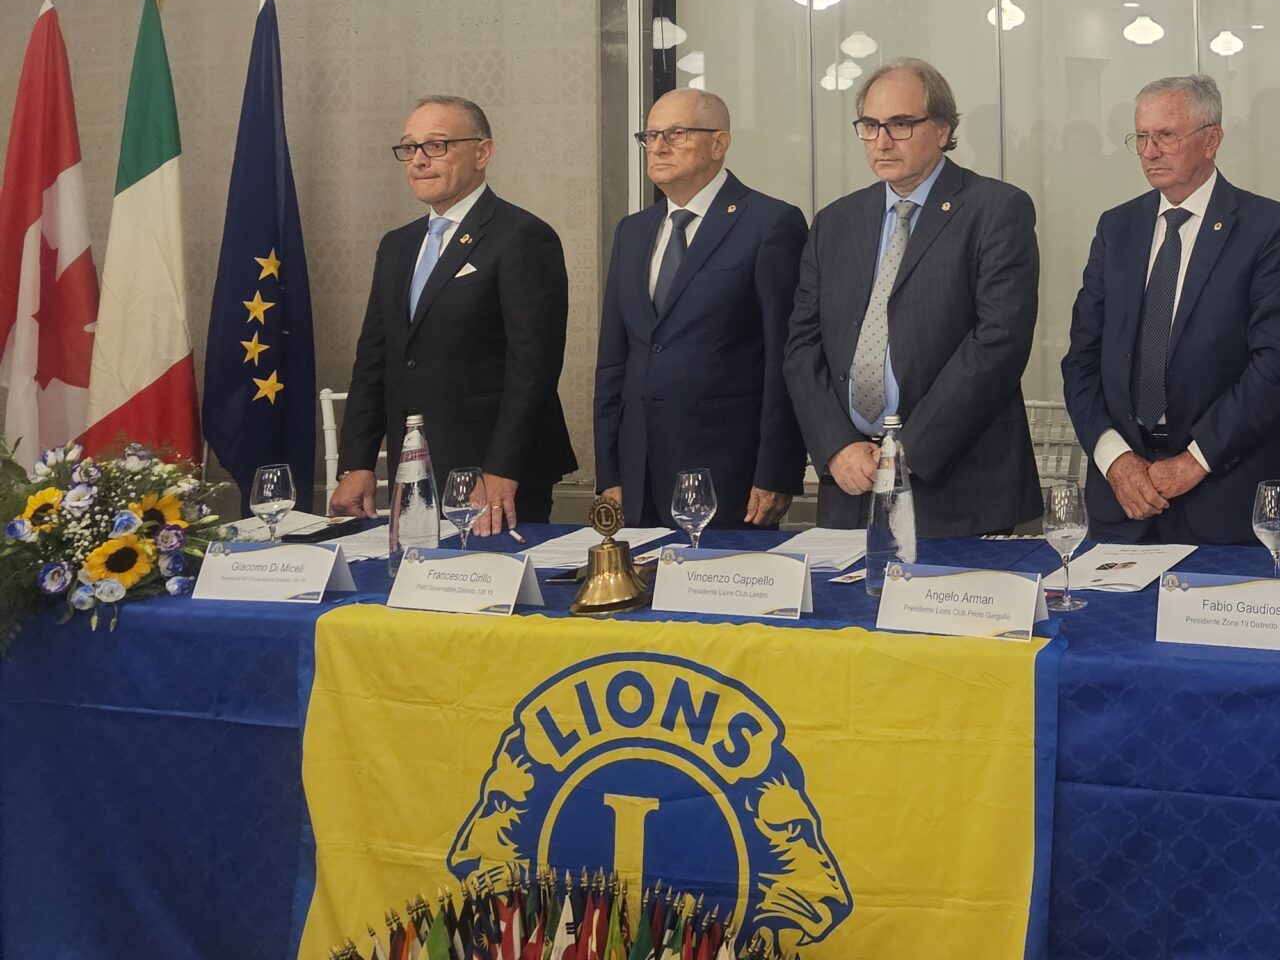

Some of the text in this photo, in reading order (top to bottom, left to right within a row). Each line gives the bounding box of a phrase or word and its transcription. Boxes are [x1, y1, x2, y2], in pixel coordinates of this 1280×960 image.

[600, 508, 612, 525] L
[232, 561, 305, 573] Giacomo Di Miceli
[427, 570, 492, 584] Francesco Cirillo
[687, 571, 774, 587] Vincenzo Cappello
[688, 587, 717, 595] Presidente
[718, 588, 733, 596] Lions
[925, 589, 994, 605] Angelo Arman
[904, 604, 935, 613] Presidente
[935, 606, 951, 615] Lions
[952, 607, 966, 616] Club
[1202, 599, 1233, 612] Fabio
[1185, 616, 1220, 625] Presidente
[1222, 619, 1239, 627] Zona
[1250, 620, 1278, 630] Distretto
[535, 670, 763, 768] LIONS
